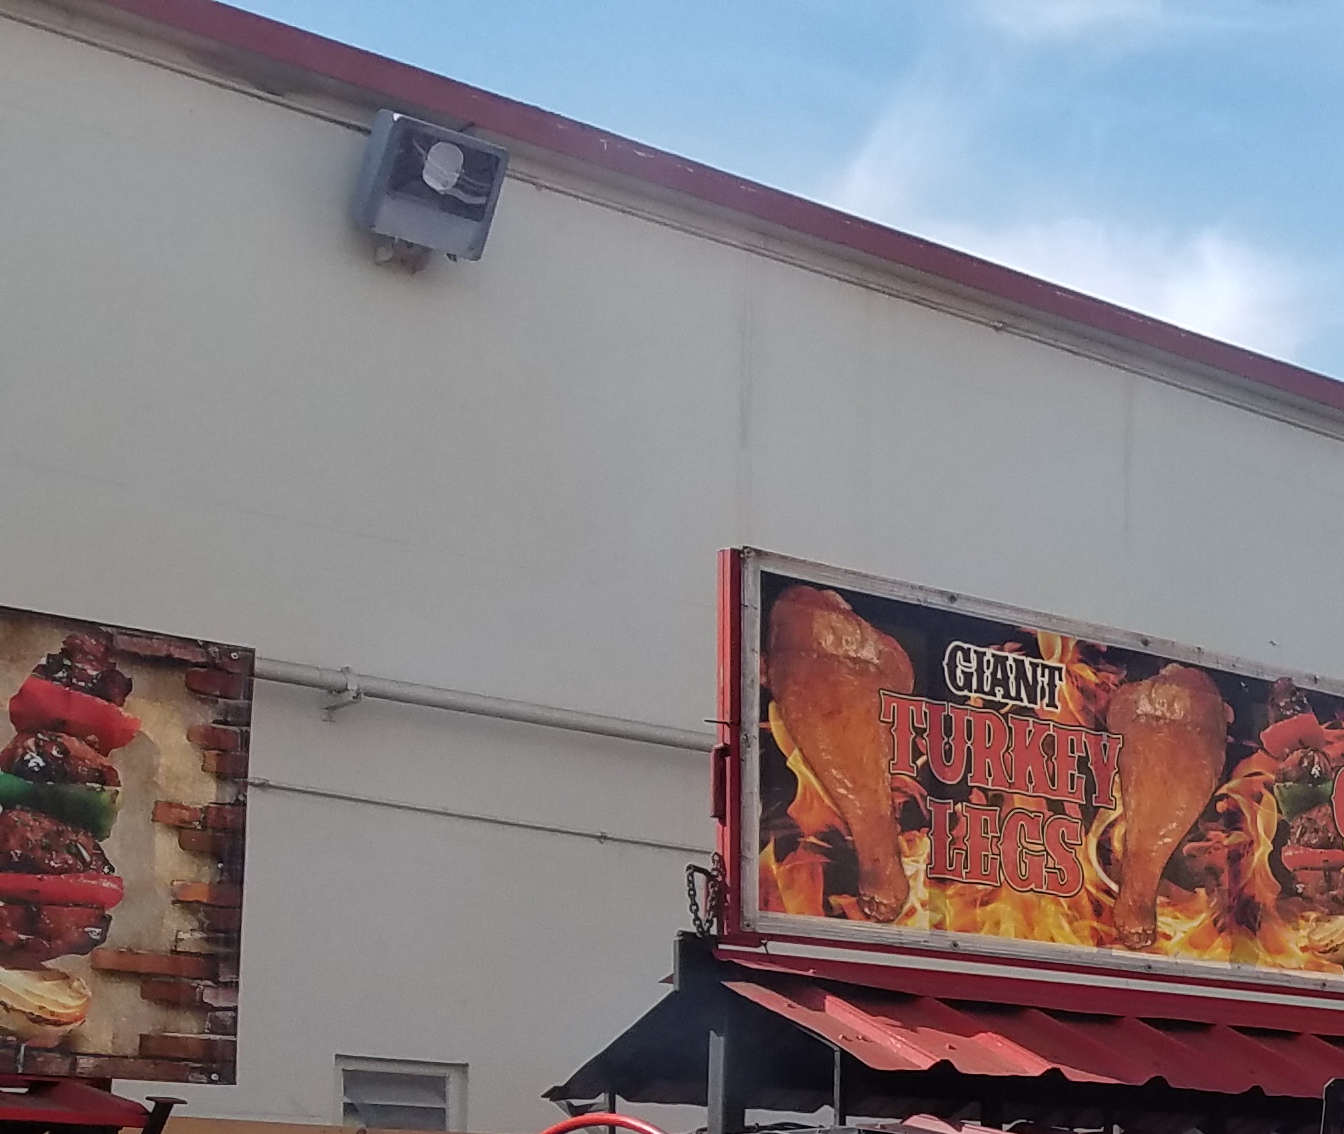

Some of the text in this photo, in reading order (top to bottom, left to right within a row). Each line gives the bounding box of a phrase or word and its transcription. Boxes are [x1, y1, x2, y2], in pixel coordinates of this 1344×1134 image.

[943, 641, 1066, 712] GIANT
[879, 689, 1123, 809] TURKEY
[926, 796, 1083, 897] LEGS
